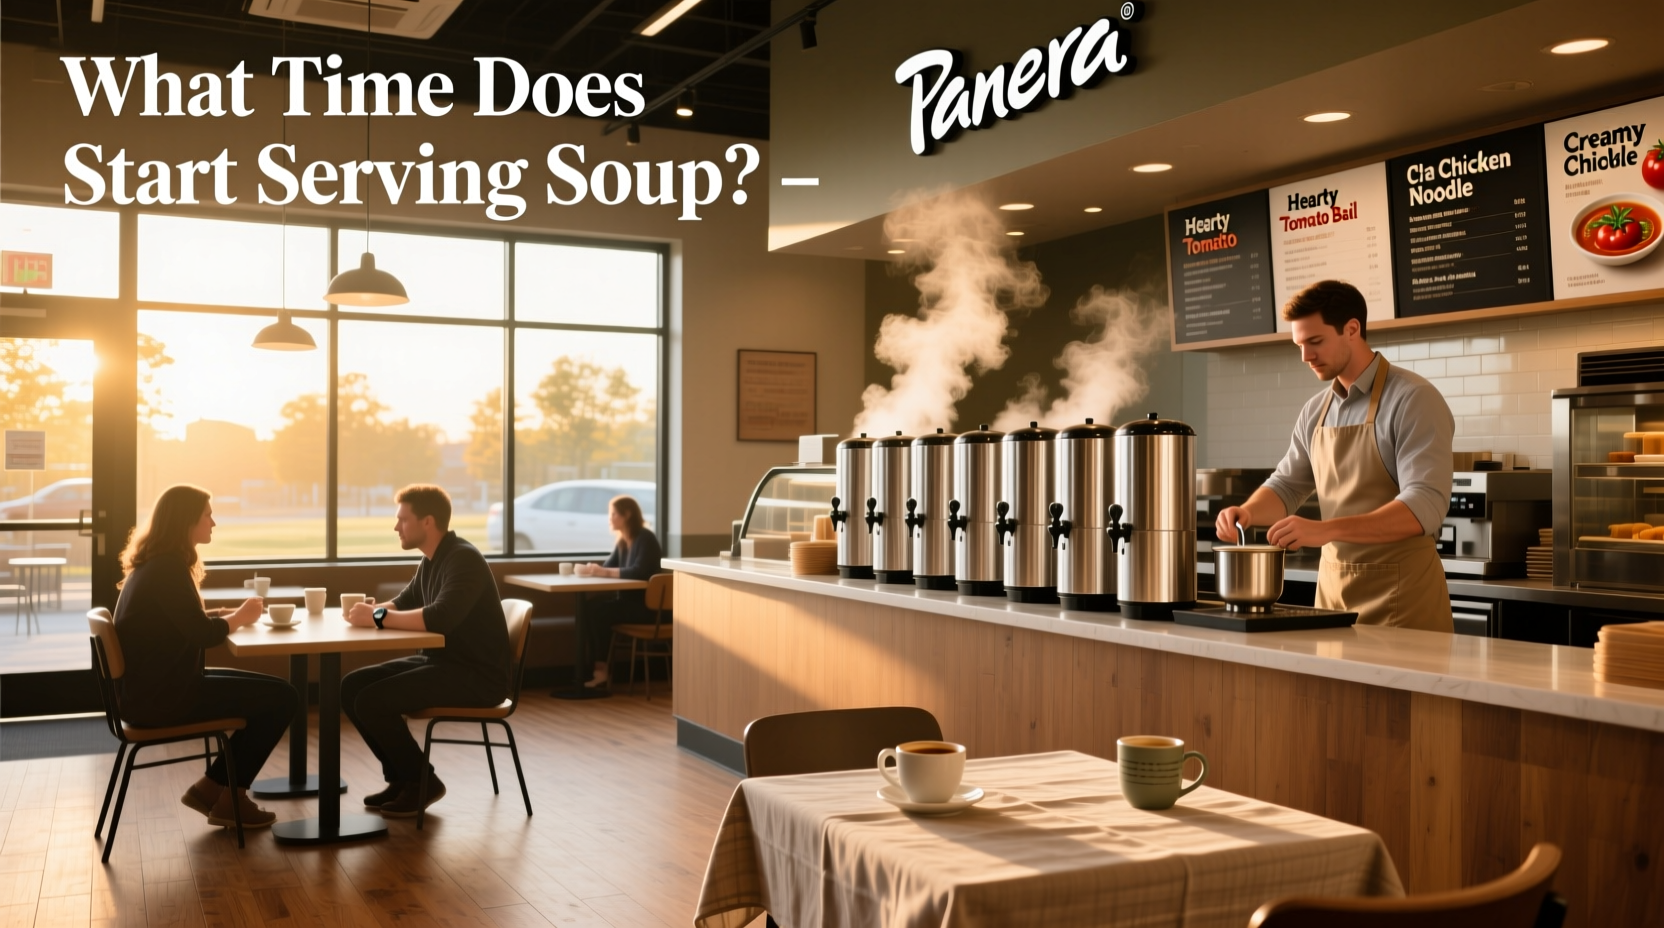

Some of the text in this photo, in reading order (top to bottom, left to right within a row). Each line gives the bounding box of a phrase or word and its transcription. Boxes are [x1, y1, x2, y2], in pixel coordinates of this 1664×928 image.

[895, 18, 1128, 155] Panera
[1563, 123, 1646, 153] Creamy
[1438, 150, 1511, 179] Chicken
[1287, 188, 1339, 212] Hearty
[1409, 178, 1473, 207] Noodle
[1185, 212, 1230, 236] Hearty
[1279, 211, 1330, 232] Tomato
